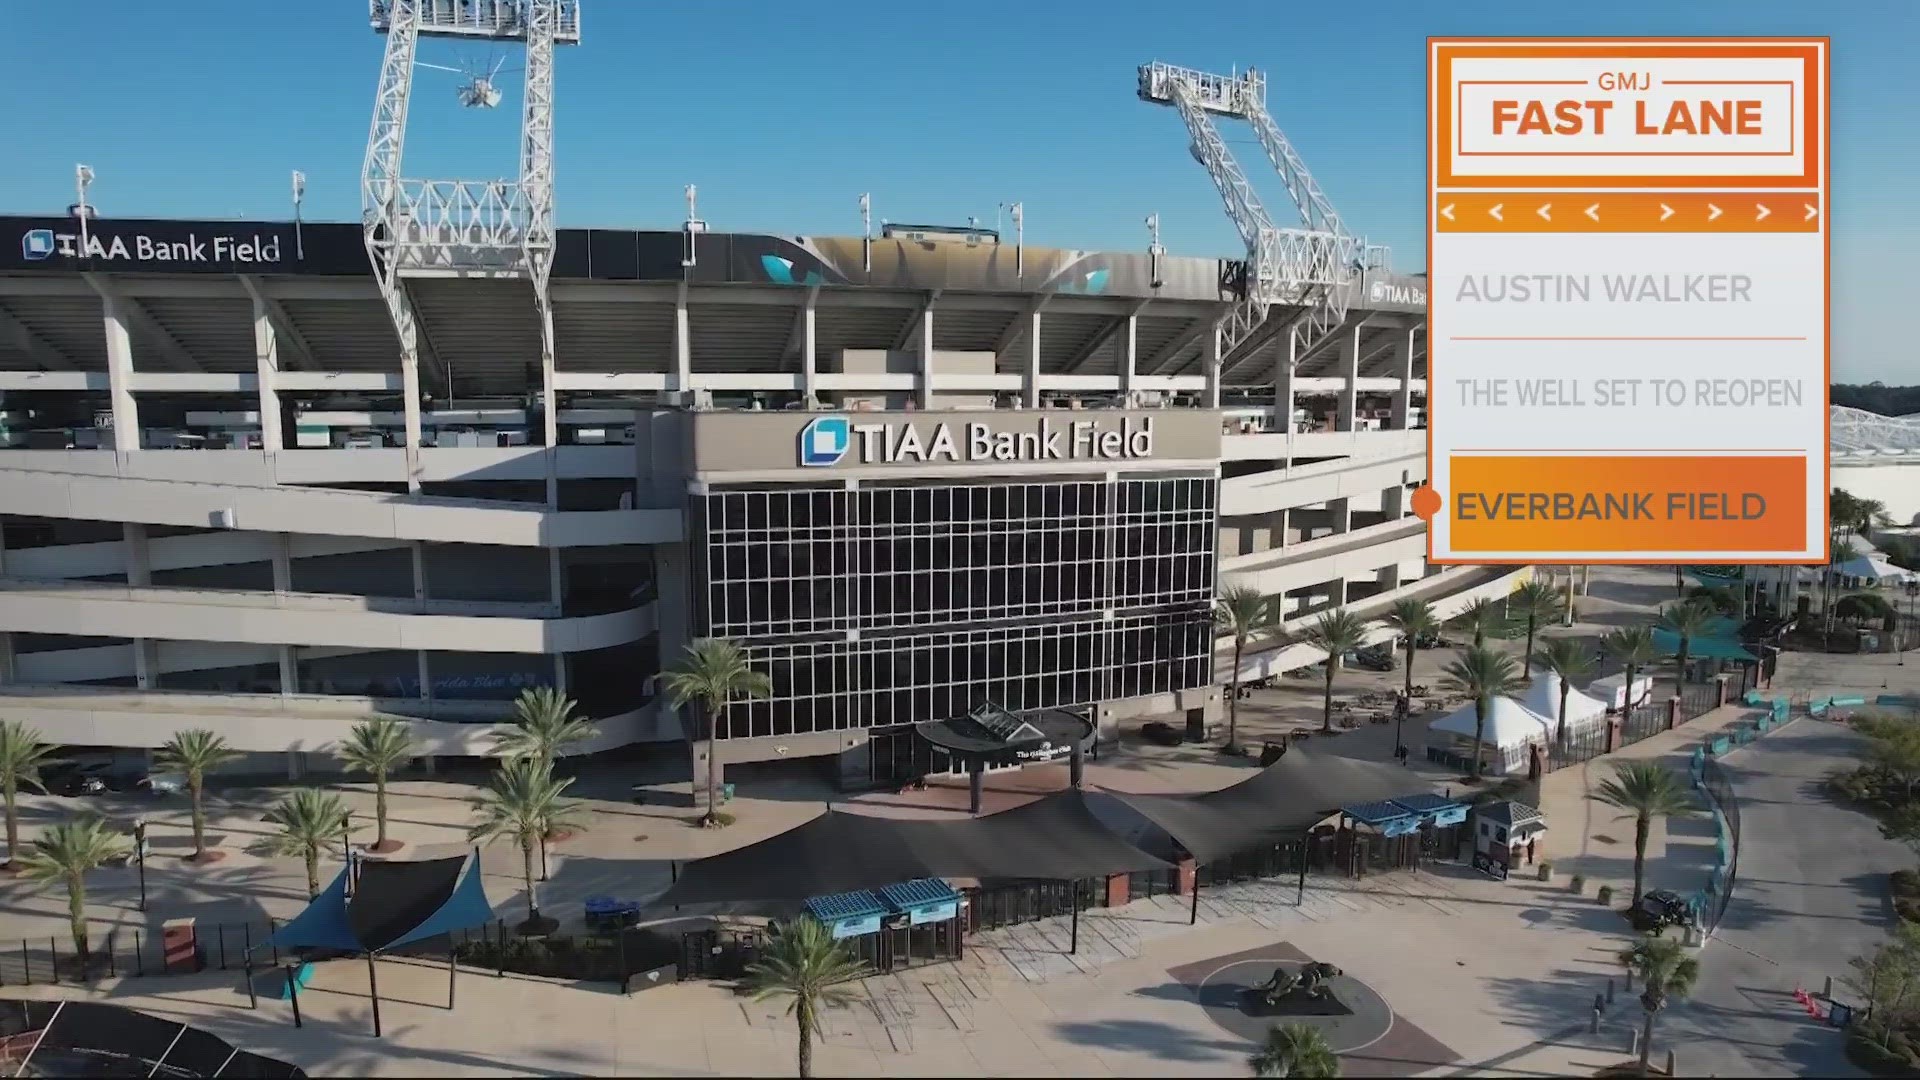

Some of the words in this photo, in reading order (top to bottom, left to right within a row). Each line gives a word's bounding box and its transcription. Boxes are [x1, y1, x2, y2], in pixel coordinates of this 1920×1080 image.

[136, 233, 207, 261] Bank
[214, 234, 281, 262] Field
[1384, 285, 1411, 304] TIAA
[1412, 286, 1427, 306] Ba
[853, 422, 960, 463] TIAA
[967, 417, 1062, 461] Bank
[1070, 417, 1154, 459] Field
